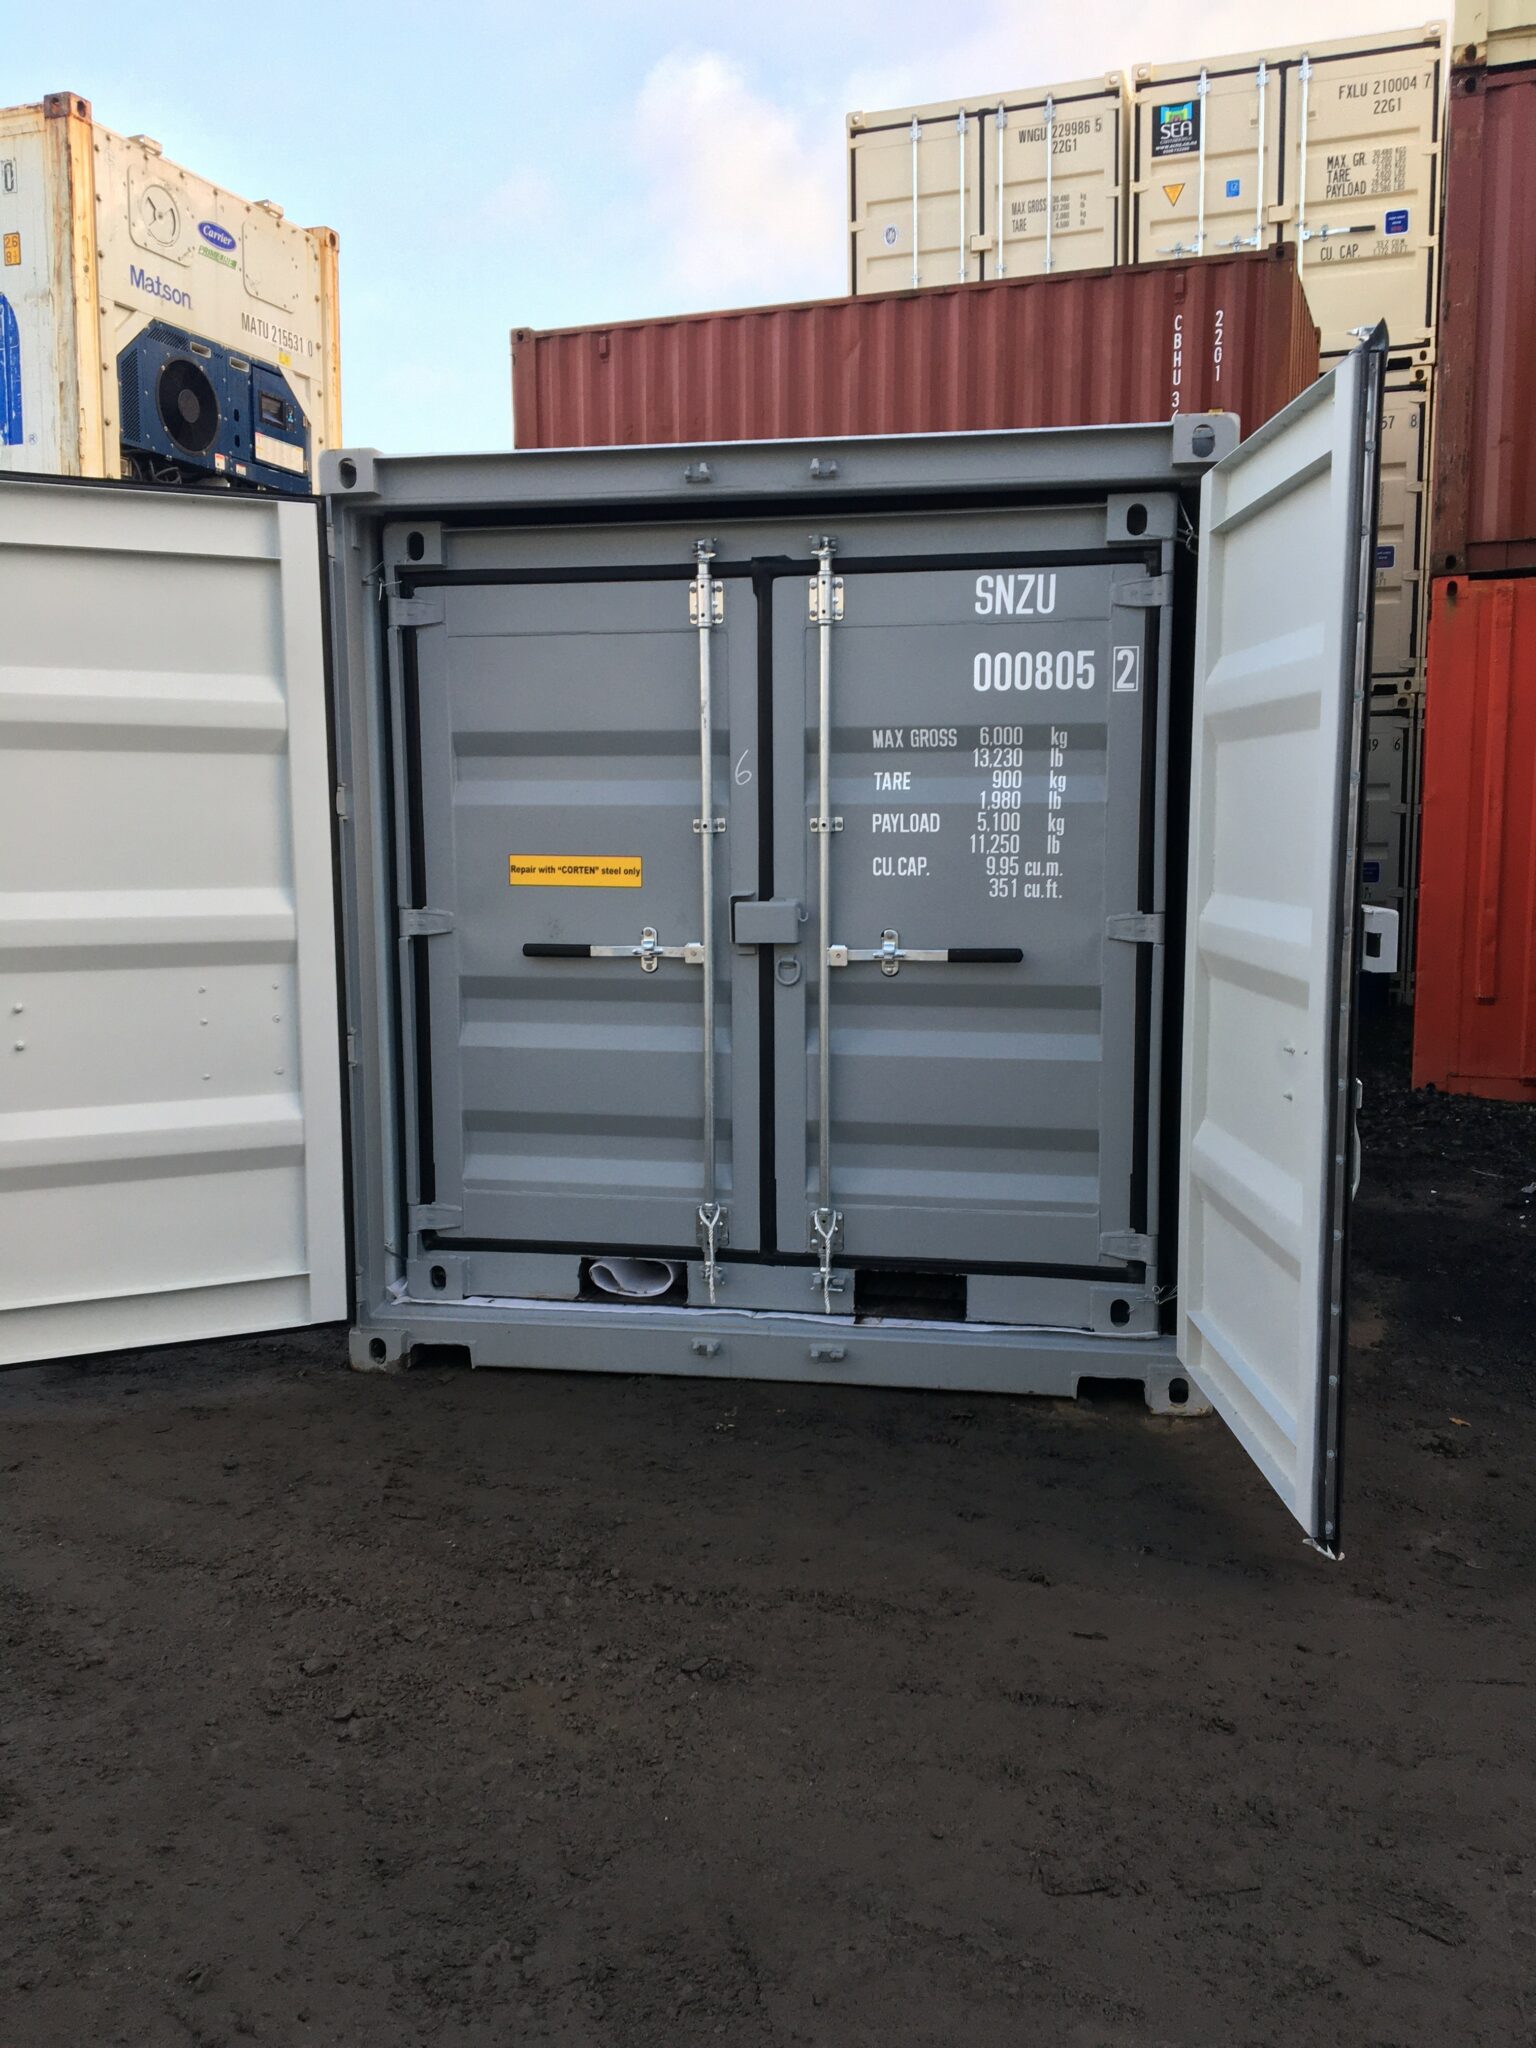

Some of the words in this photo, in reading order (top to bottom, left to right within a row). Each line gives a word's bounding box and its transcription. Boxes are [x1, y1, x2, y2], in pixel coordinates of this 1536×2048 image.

[1339, 82, 1368, 100] FXLU
[1373, 75, 1417, 96] 210004
[1424, 73, 1431, 88] 7
[1373, 97, 1402, 115] 22G1
[1018, 126, 1047, 144] WNGU
[1052, 120, 1091, 139] 229986
[1095, 117, 1102, 133] 5
[1160, 120, 1192, 140] SEA
[1052, 138, 1077, 154] 22G1
[1327, 168, 1351, 184] TARE
[1326, 180, 1367, 199] PAYLOAD
[1011, 201, 1026, 216] MAX
[1027, 198, 1047, 214] GROSS
[203, 224, 233, 246] Carrier
[1012, 218, 1027, 233] TARE
[129, 264, 192, 310] Matson
[241, 312, 269, 339] MATU
[271, 325, 304, 354] 215531
[1173, 314, 1183, 386] CBHU
[1213, 310, 1224, 382] 22G1
[1411, 414, 1417, 428] 8
[974, 574, 1057, 615] SNZU
[973, 650, 1096, 692] 000805
[1115, 648, 1136, 690] 2
[872, 730, 903, 749] MAX
[910, 728, 957, 748] GROSS
[980, 726, 1023, 747] 6,000
[1051, 726, 1068, 749] kg
[734, 750, 752, 786] 6
[972, 747, 1023, 769] 13,230
[1050, 747, 1063, 768] lb
[874, 771, 911, 791] TARE
[992, 769, 1022, 789] 900
[1049, 769, 1066, 793] kg
[980, 790, 1021, 811] 1,980
[1048, 790, 1062, 810] lb
[872, 813, 941, 833] PAYLOAD
[1047, 812, 1065, 836] kg
[969, 834, 1020, 855] 11,250
[1046, 834, 1060, 854] lb
[510, 865, 537, 876] Repair
[538, 865, 556, 875] with
[601, 866, 622, 876] steel
[623, 867, 641, 878] only
[872, 857, 931, 876] CU.CAP.
[986, 856, 1019, 876] 9.95
[1024, 860, 1064, 877] cu.m.
[988, 878, 1017, 898] 351
[1024, 879, 1063, 899] cu.ft.
